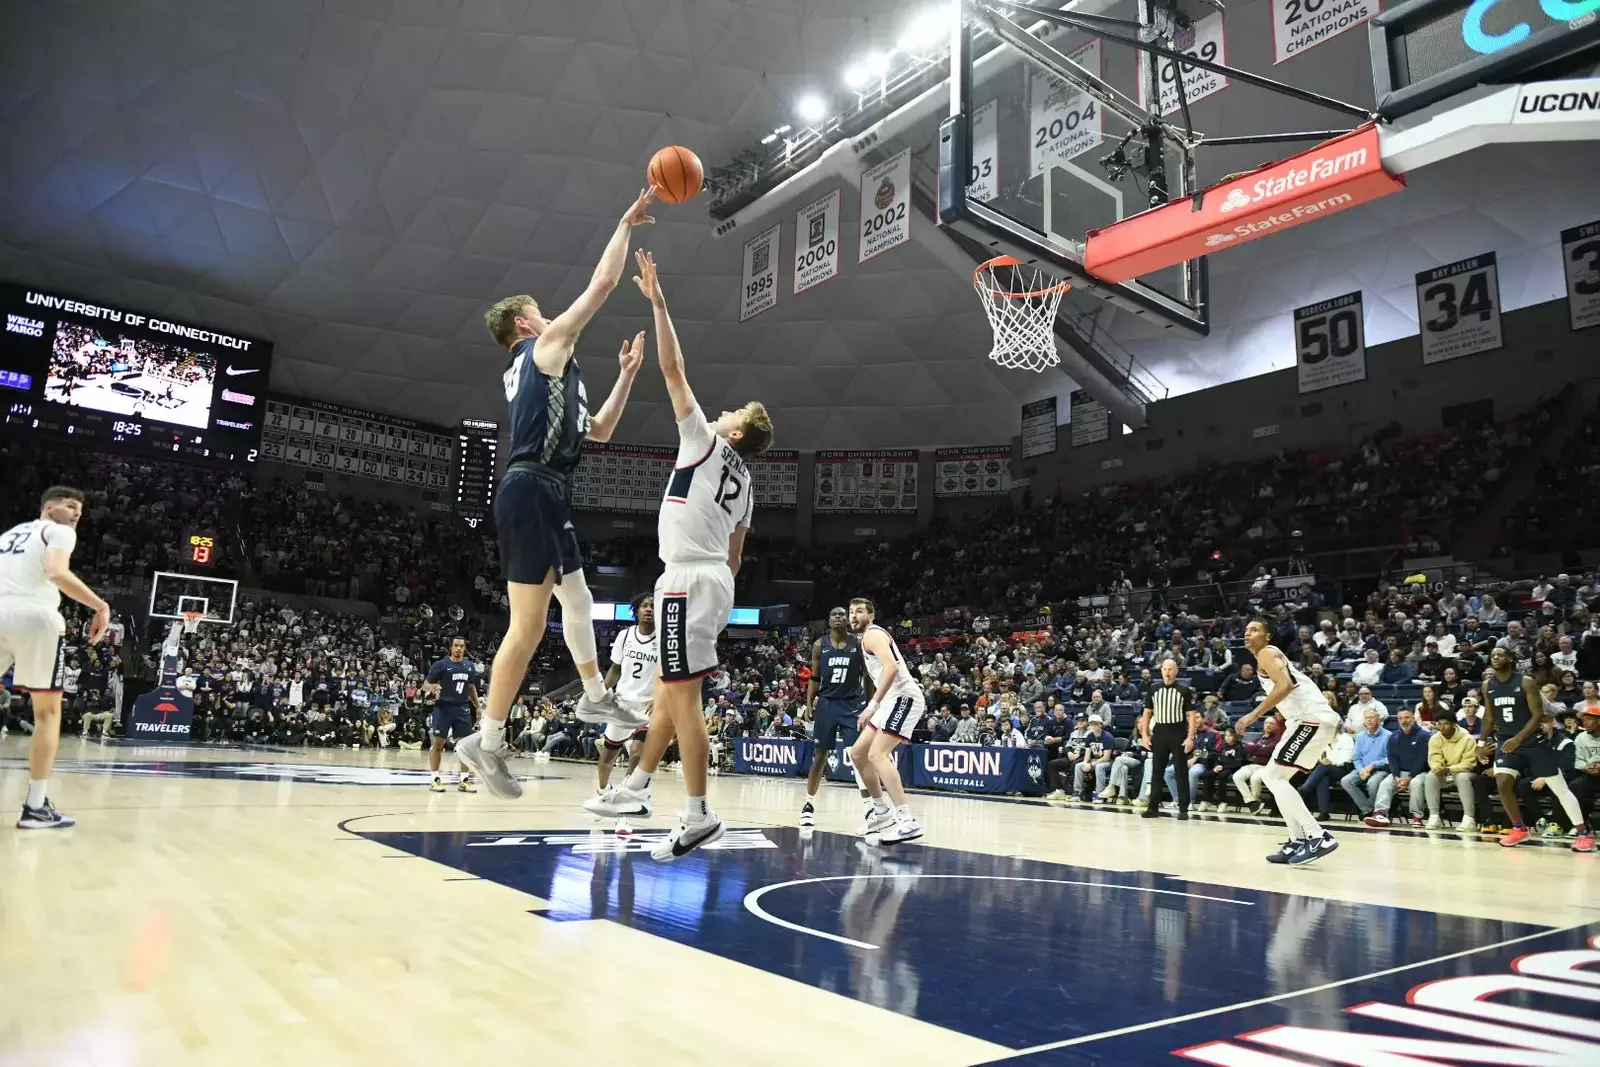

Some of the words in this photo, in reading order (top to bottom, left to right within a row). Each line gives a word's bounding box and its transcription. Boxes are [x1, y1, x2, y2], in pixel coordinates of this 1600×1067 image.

[1291, 0, 1360, 37] NATIONAL
[1286, 7, 1368, 53] CHAMPIONS
[1161, 41, 1217, 84] 009
[1161, 70, 1211, 99] ATONAL
[1519, 92, 1600, 113] UCON
[1035, 101, 1096, 148] 2004
[1042, 128, 1090, 157] ATIONAL
[1038, 137, 1094, 170] CMPIONS
[972, 157, 992, 182] 03
[863, 202, 906, 237] 2002
[863, 233, 904, 258] CHAMPIONS
[867, 225, 901, 246] NATIONAL
[797, 240, 835, 272] 2000
[797, 268, 833, 290] CHAMPIONS
[800, 260, 831, 279] NATIONAL
[1432, 268, 1448, 280] RAY
[1451, 260, 1478, 276] ALLEN
[746, 273, 773, 298] 1995
[744, 299, 773, 318] CHAMPIONS
[746, 291, 771, 308] NATIONAL
[1301, 301, 1332, 317] REBECCA
[1334, 295, 1354, 308] LOBO
[1424, 271, 1492, 332] 34
[6, 322, 43, 337] FARGO
[7, 313, 45, 329] WELLS
[25, 291, 123, 322] UNIVERSITY
[125, 313, 145, 326] OF
[148, 318, 252, 351] CONNECTICUT
[1301, 310, 1358, 364] 50
[112, 421, 142, 436] 18:25
[247, 449, 258, 462] 2
[264, 443, 280, 456] 23
[316, 452, 330, 465] 30
[436, 446, 446, 457] 14
[343, 457, 351, 469] 3
[388, 466, 398, 477] 15
[408, 469, 424, 481] 24
[431, 474, 446, 486] 33
[714, 464, 742, 516] 12
[190, 535, 214, 547] 18:25
[193, 546, 209, 563] 13
[666, 602, 681, 673] HUSKIES
[632, 662, 643, 679] 2
[830, 668, 848, 684] 21
[455, 682, 464, 694] 4
[889, 696, 909, 731] HUSKIES
[1502, 707, 1513, 722] 5
[135, 722, 191, 734] TRAVELERS
[742, 742, 797, 765] UCONN
[1283, 725, 1313, 763] HUSKIES
[924, 748, 1001, 776] UCONN
[933, 776, 985, 787] BASKETBALL
